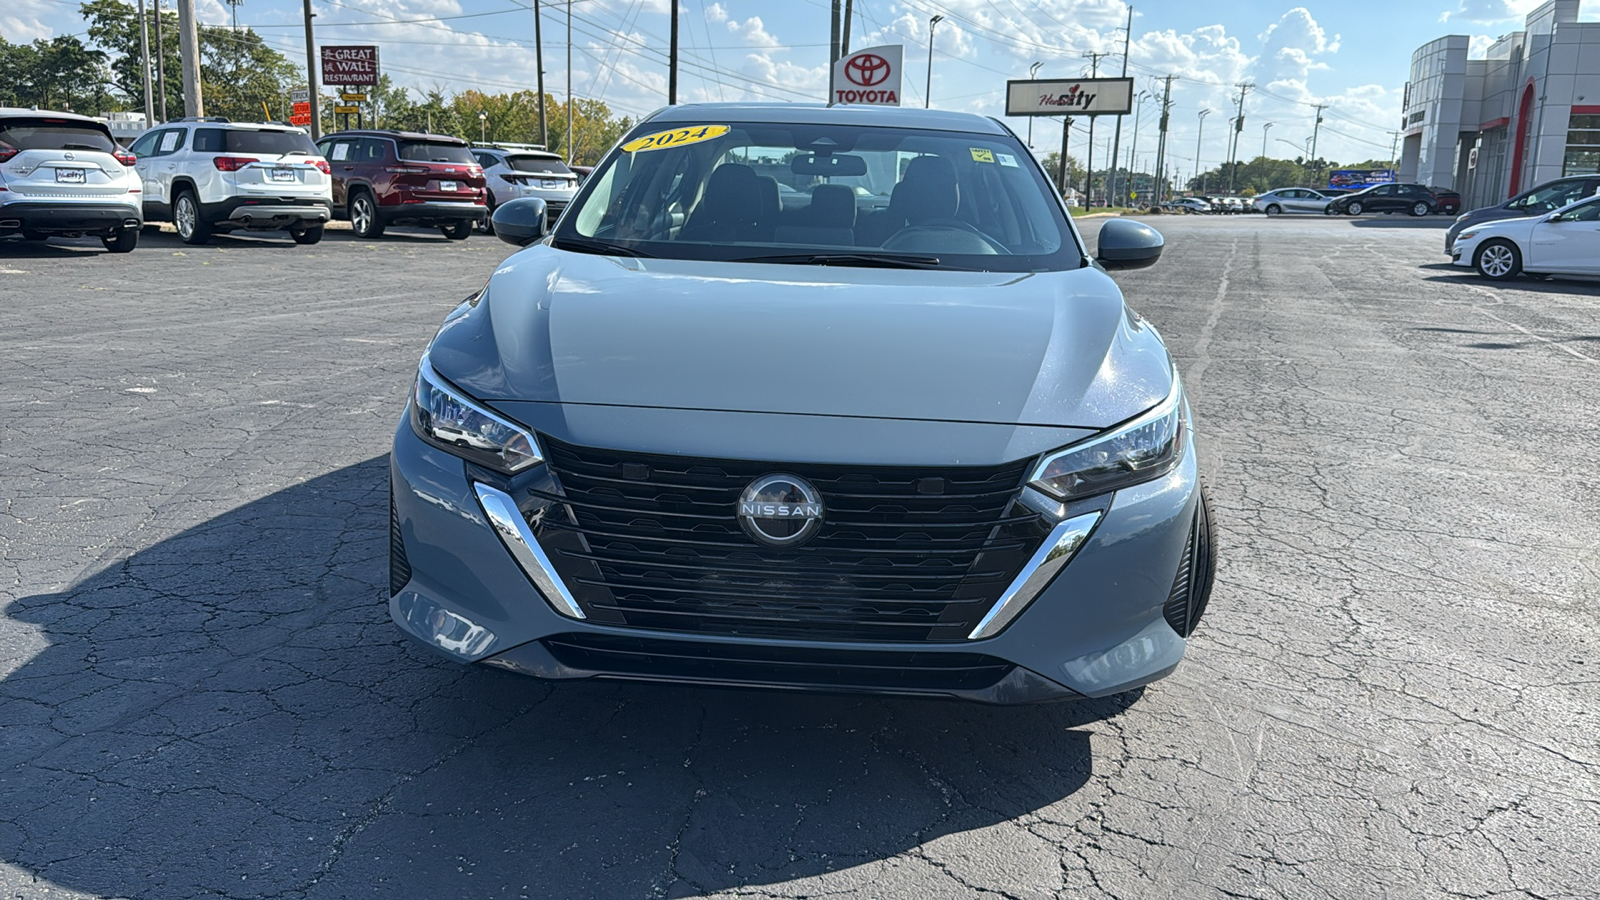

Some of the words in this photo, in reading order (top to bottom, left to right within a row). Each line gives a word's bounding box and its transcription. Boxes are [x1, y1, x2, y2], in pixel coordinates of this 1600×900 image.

[335, 49, 373, 60] GREAT
[336, 61, 372, 72] WALL
[324, 74, 375, 82] RESTAURANT
[292, 91, 309, 100] TRUCK
[836, 90, 898, 104] TOYOTA
[295, 104, 309, 112] DETOUR
[638, 126, 710, 151] 2024
[742, 504, 819, 516] NISSAN
